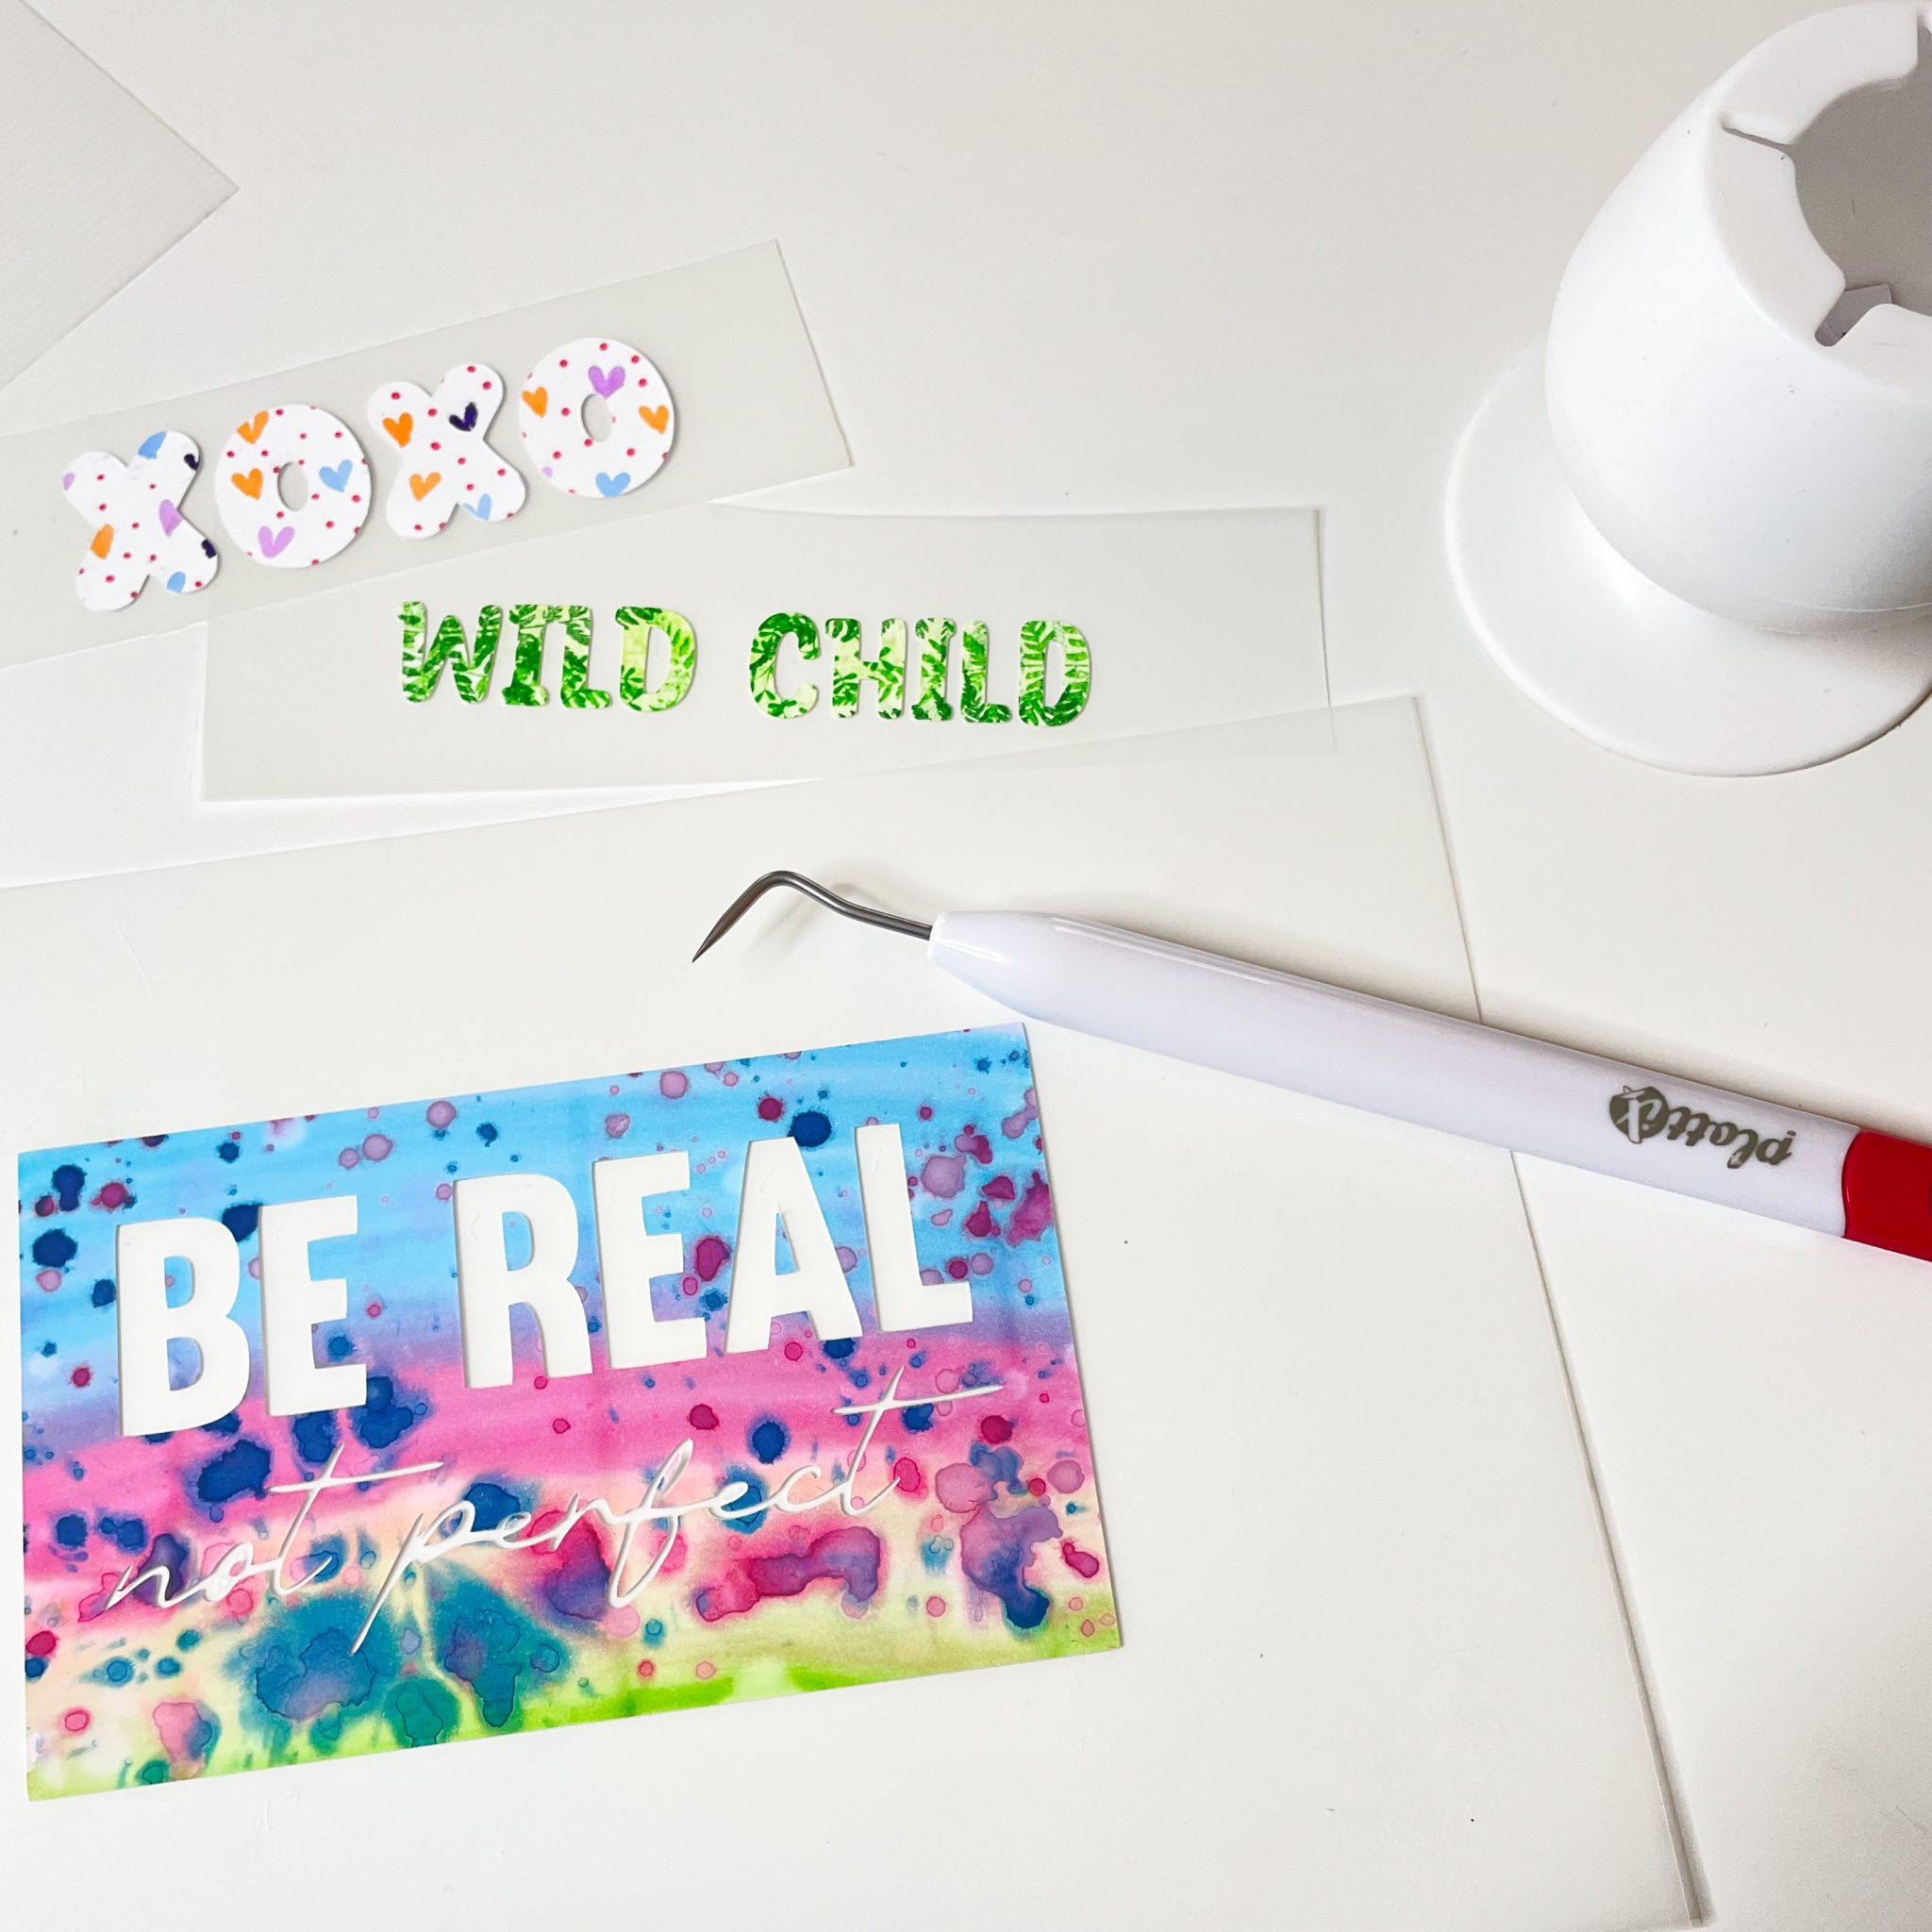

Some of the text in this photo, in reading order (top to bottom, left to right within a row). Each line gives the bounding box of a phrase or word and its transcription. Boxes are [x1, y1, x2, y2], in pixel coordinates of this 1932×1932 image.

[62, 337, 675, 612] XOXO
[397, 601, 1092, 728] WILD CHILD
[117, 1124, 974, 1437] BE REAL
[106, 1365, 1005, 1656] not perfect
